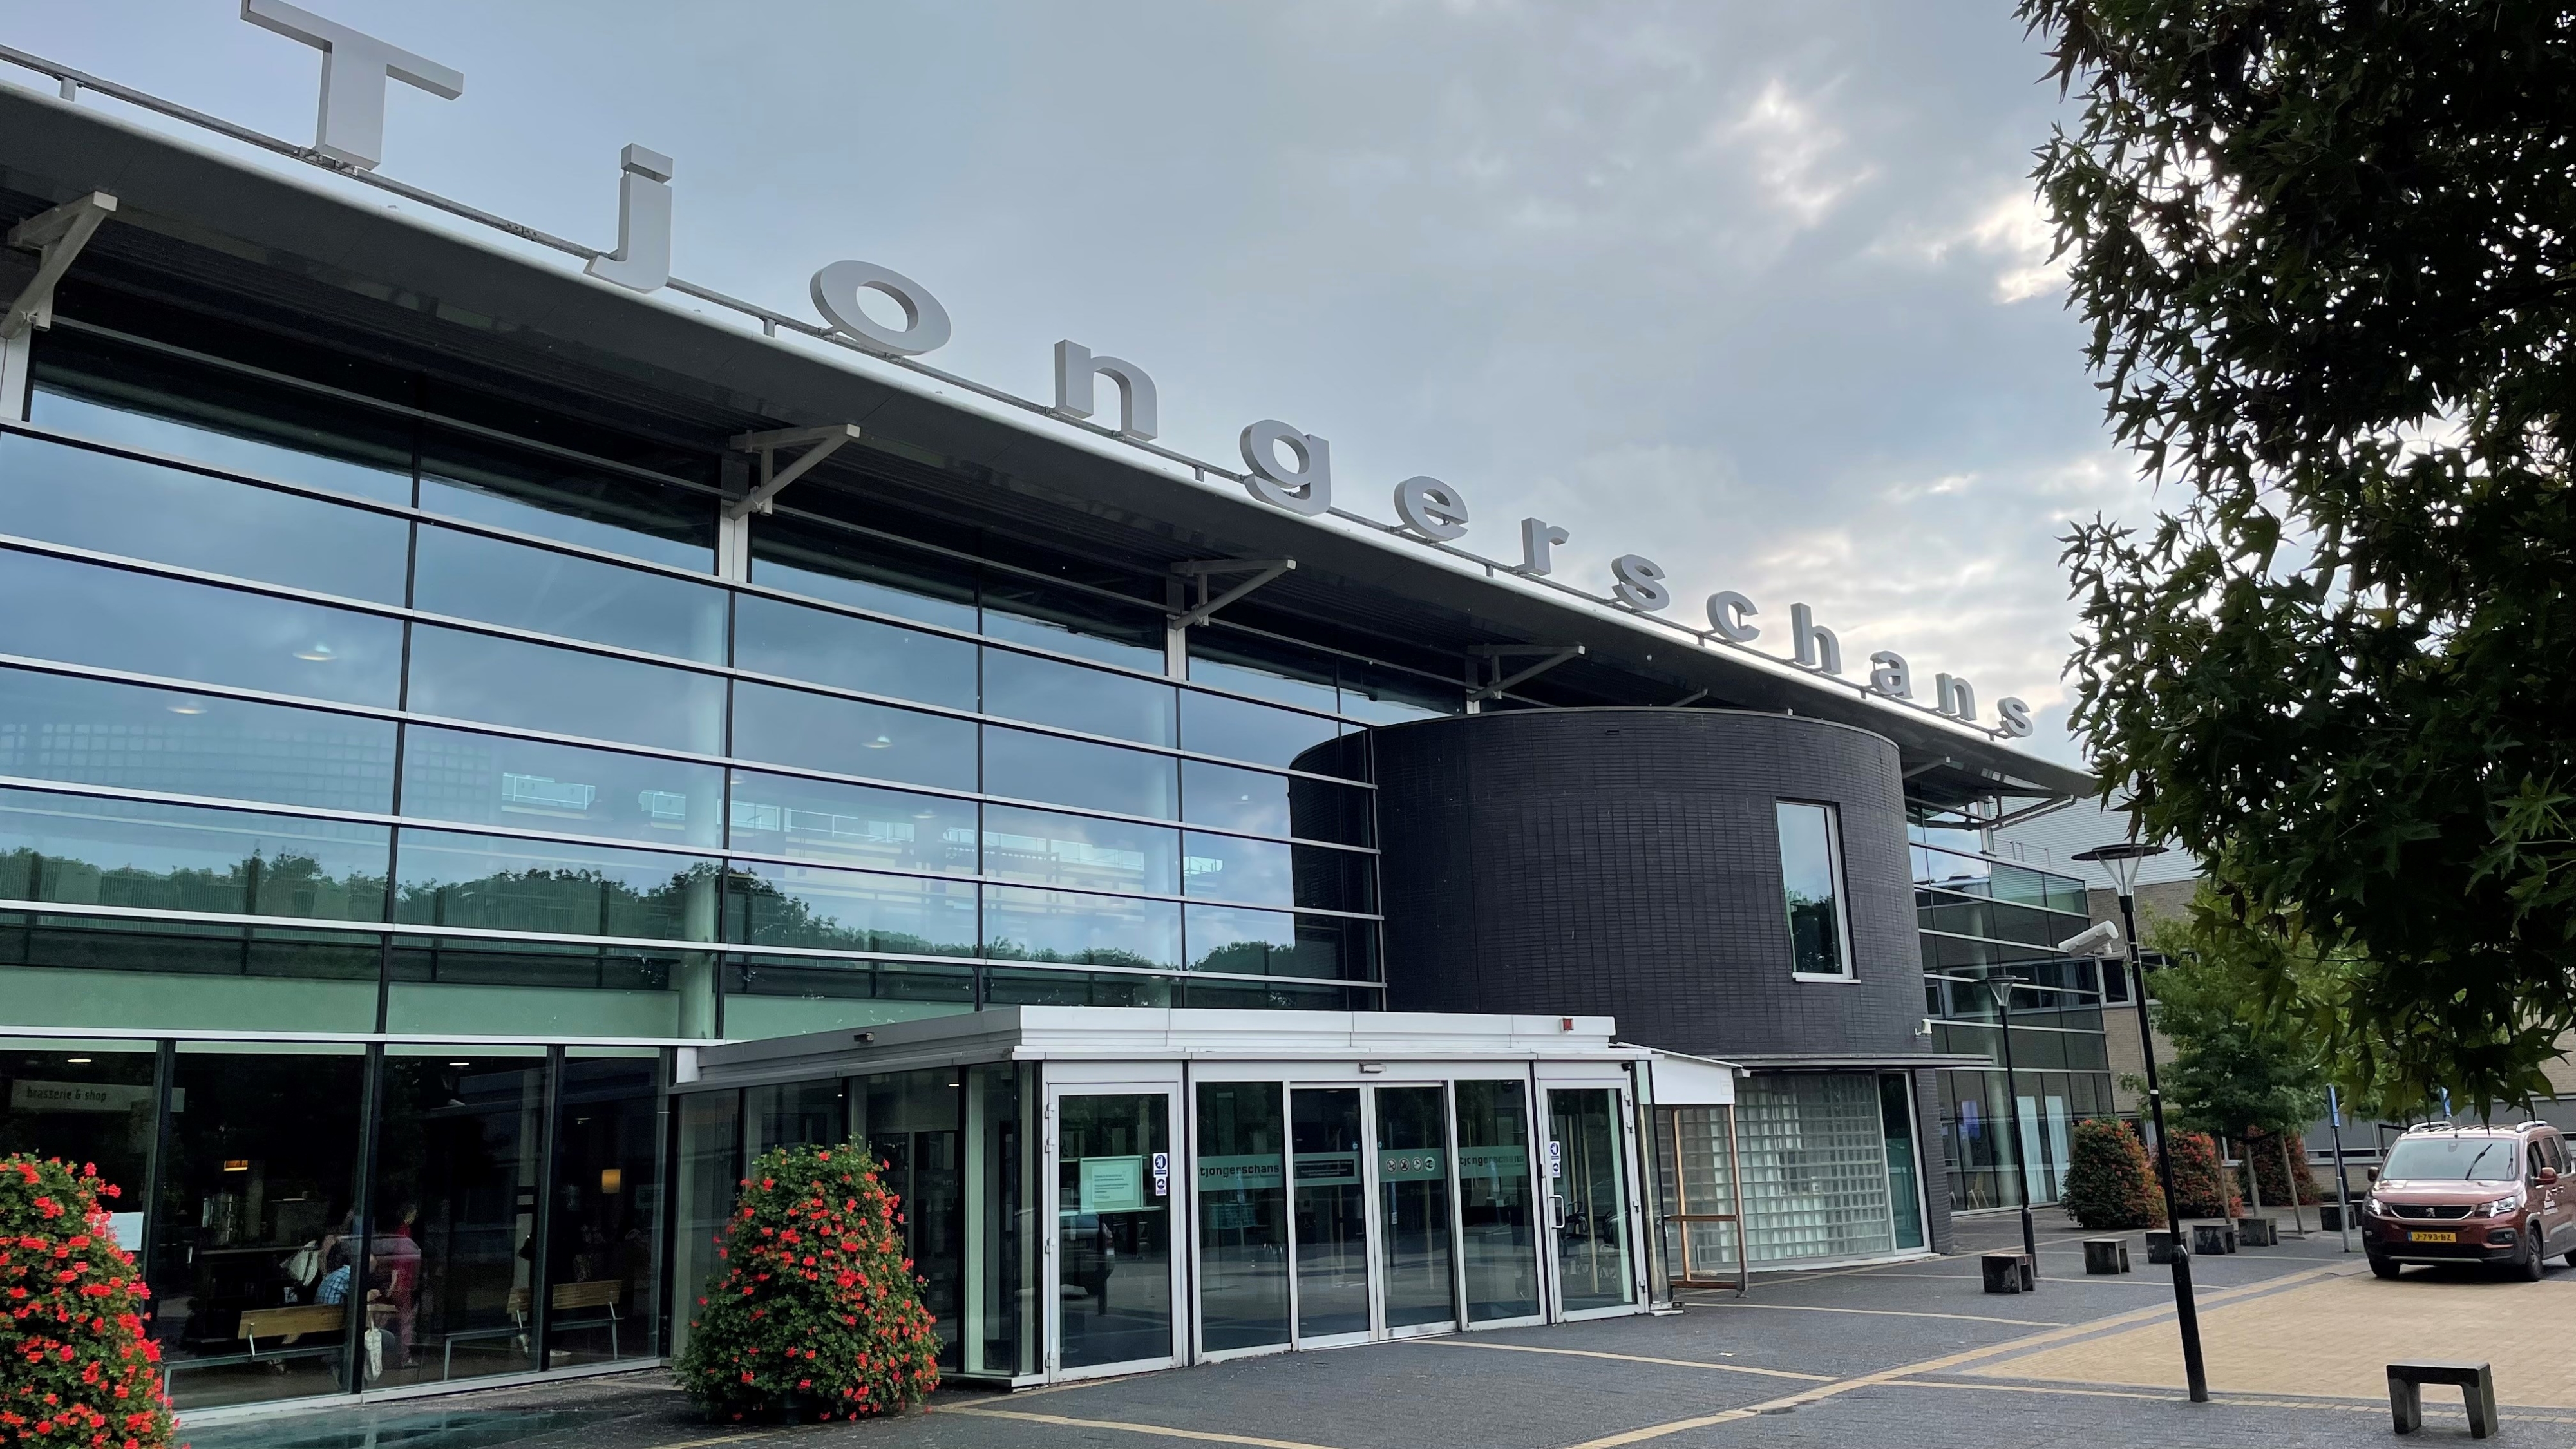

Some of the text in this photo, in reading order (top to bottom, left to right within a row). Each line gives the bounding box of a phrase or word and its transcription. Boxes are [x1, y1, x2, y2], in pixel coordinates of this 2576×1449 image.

[241, 0, 2036, 738] Tjongerschans
[26, 1085, 107, 1104] brasserie & shop
[1459, 1155, 1524, 1167] tjongerschans
[1200, 1164, 1280, 1178] tjongerschans
[2416, 1233, 2452, 1241] J-793-BZ
